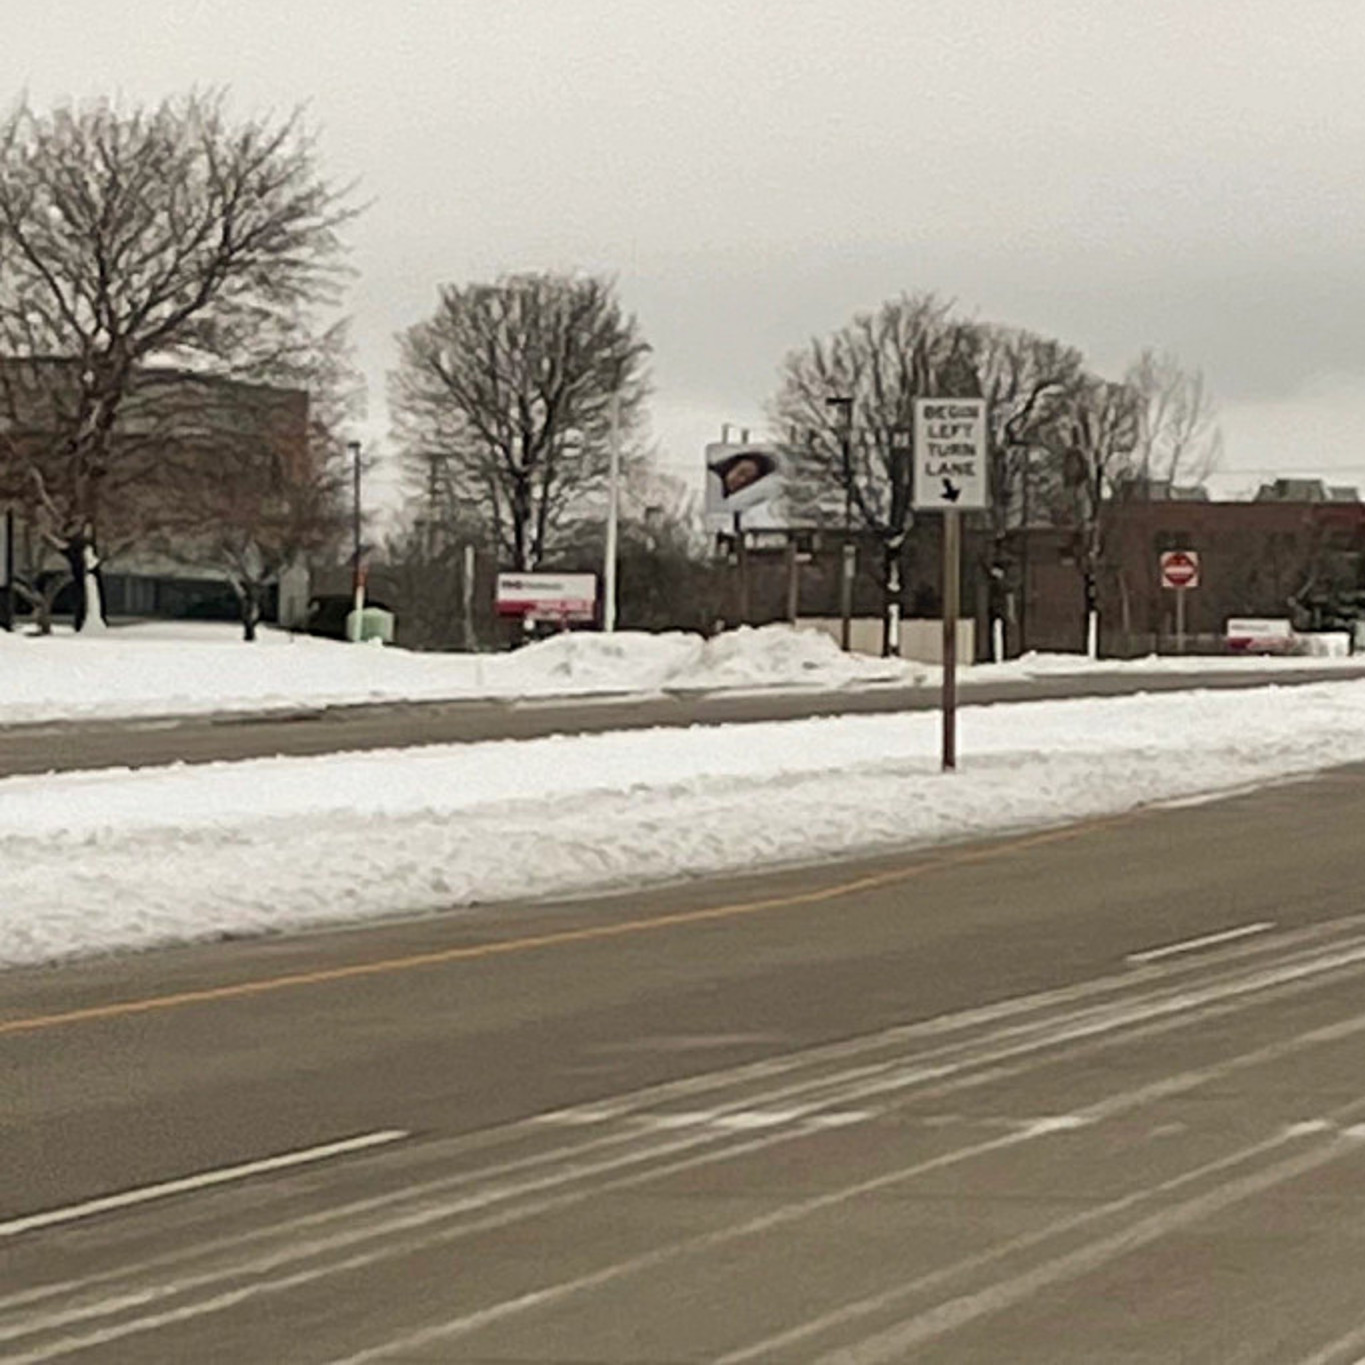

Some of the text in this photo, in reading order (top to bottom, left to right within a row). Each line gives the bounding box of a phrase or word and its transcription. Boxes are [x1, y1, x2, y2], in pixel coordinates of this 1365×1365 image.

[928, 423, 973, 439] LEFT
[927, 443, 976, 457] TURN
[925, 462, 976, 477] LANE
